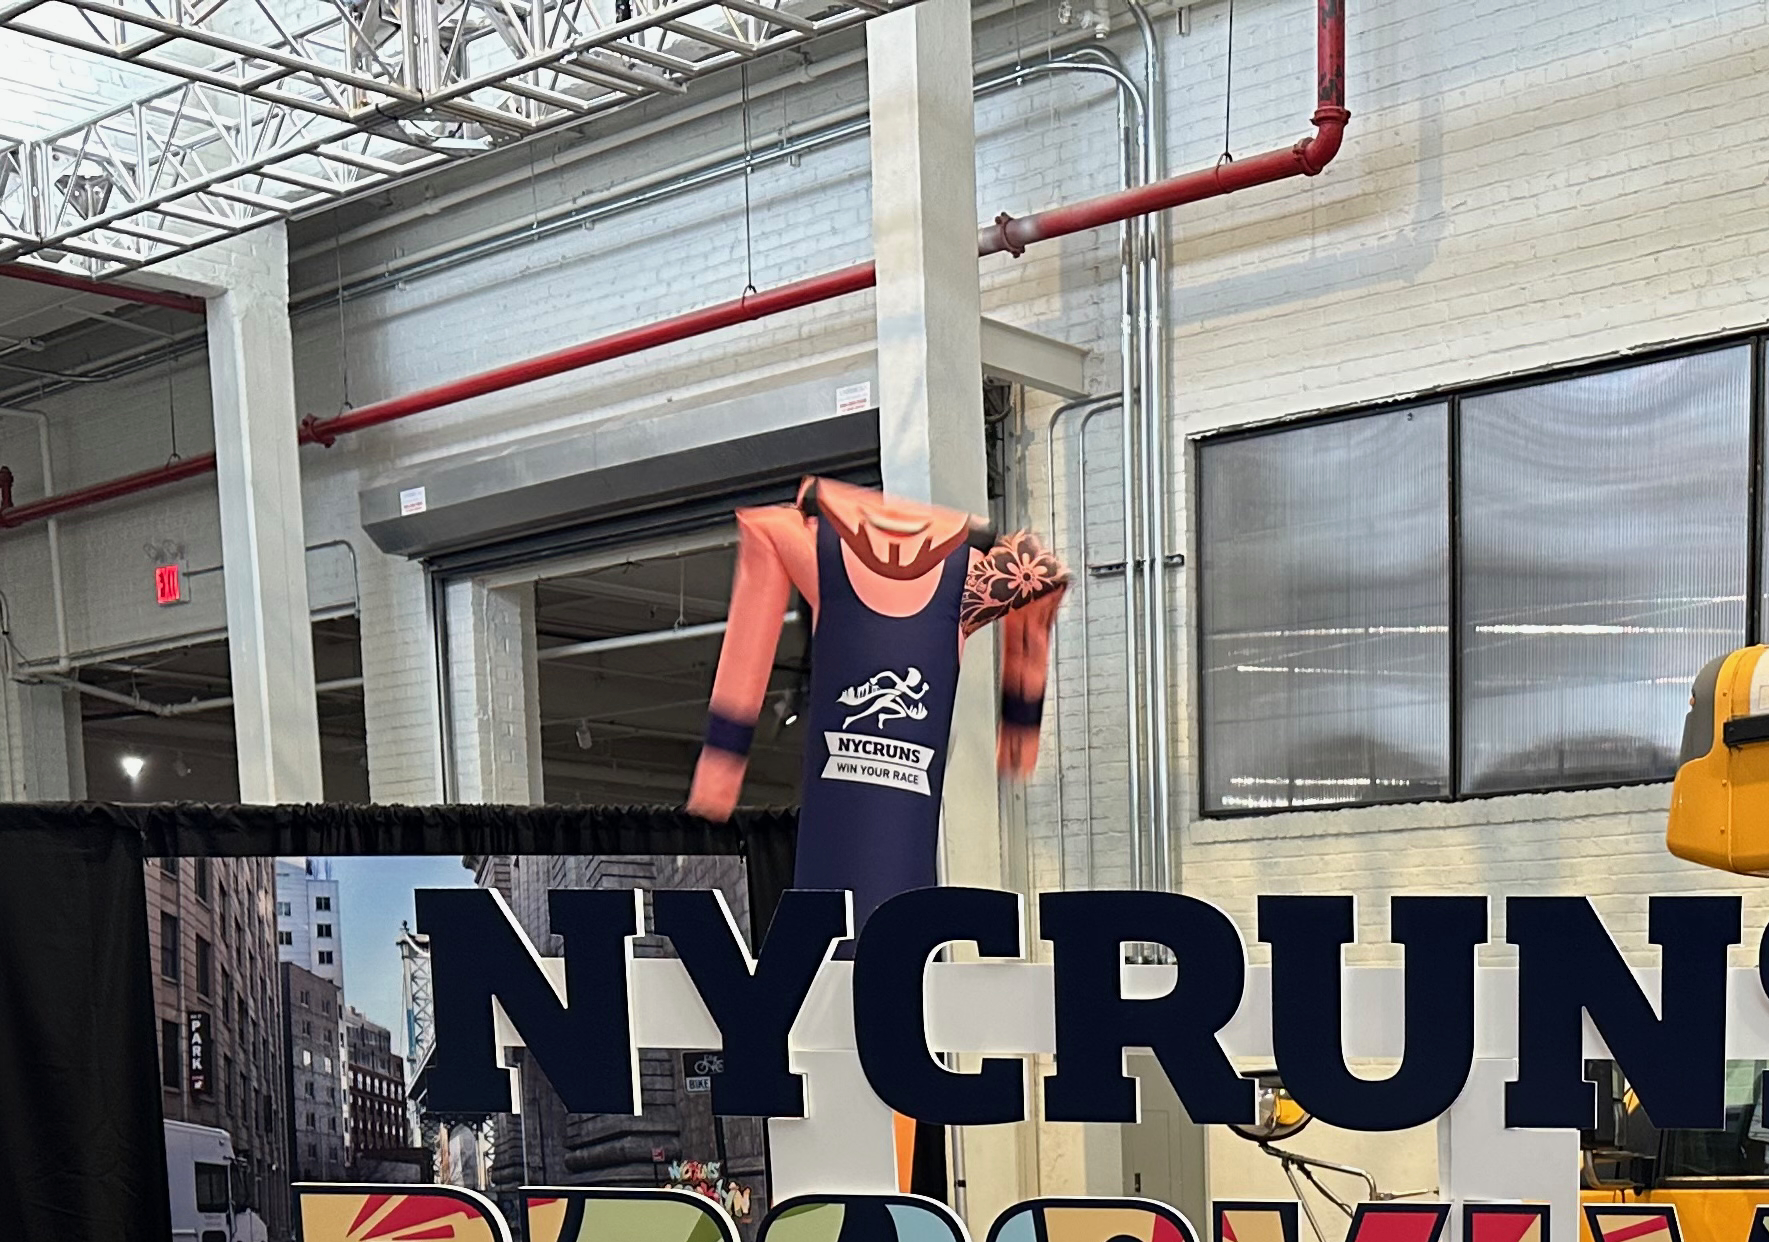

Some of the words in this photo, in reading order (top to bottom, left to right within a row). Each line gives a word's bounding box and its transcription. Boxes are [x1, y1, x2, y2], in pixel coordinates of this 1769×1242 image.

[838, 737, 921, 763] NYCRUNS
[837, 763, 857, 774] WIN
[860, 766, 890, 779] YOUR
[893, 771, 919, 785] RACE
[191, 1020, 203, 1070] PARK
[688, 1078, 709, 1090] BIKE
